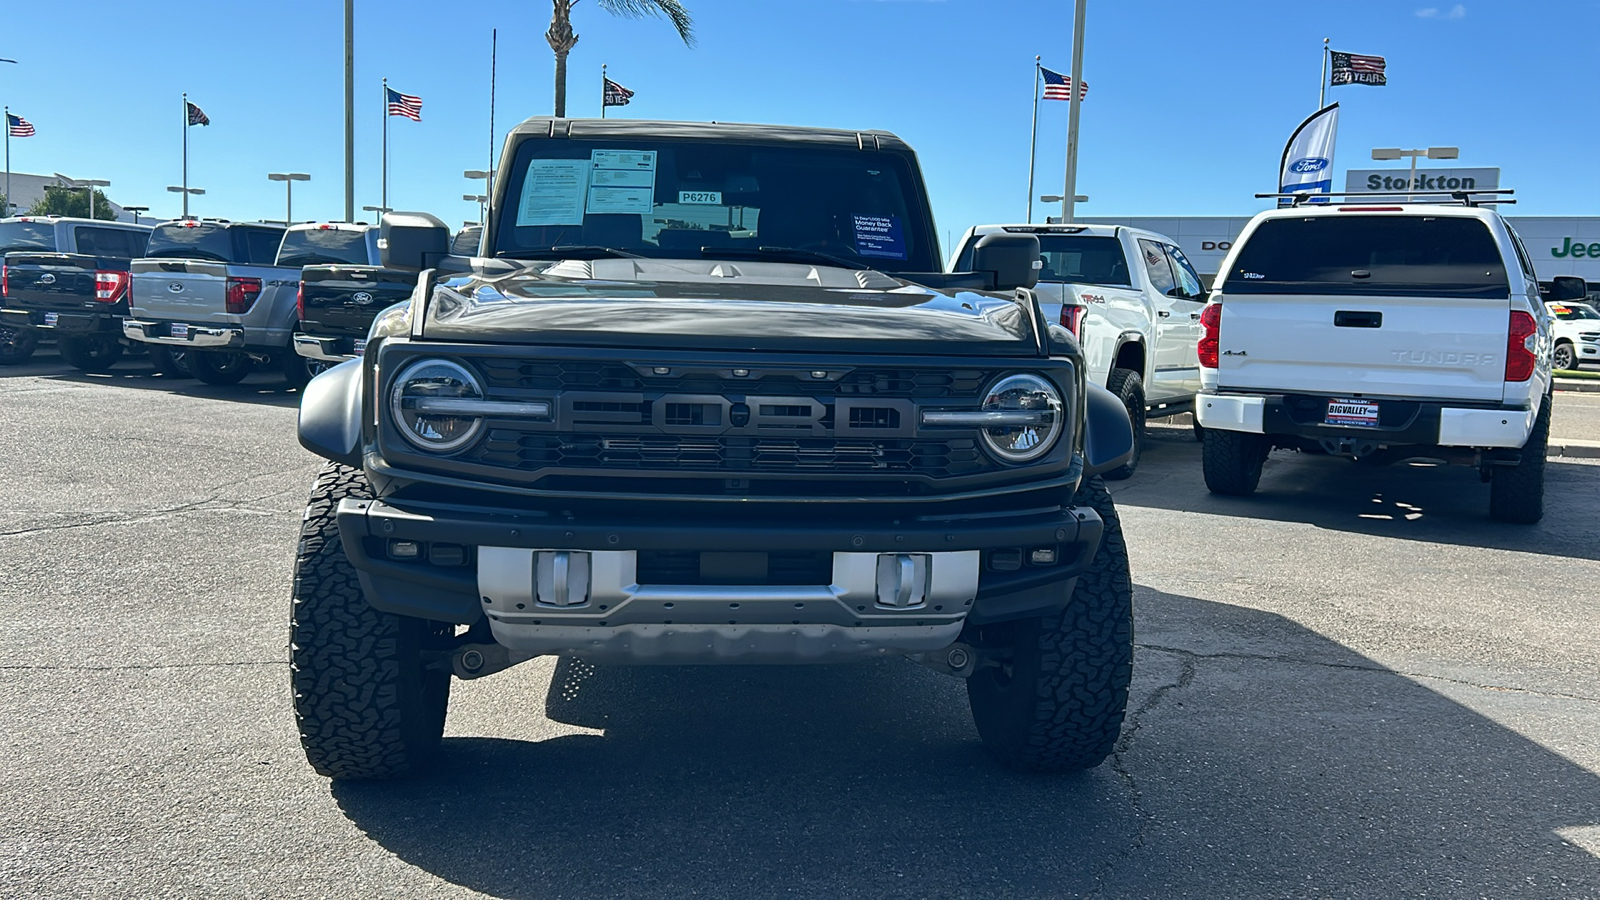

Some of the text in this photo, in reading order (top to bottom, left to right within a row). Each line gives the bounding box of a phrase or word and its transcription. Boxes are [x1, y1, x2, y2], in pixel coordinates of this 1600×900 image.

[1354, 72, 1386, 83] YEARS
[1296, 159, 1323, 172] Ford
[1367, 174, 1475, 190] Stockton
[683, 192, 716, 202] P6276
[1391, 350, 1498, 366] TUNDRA
[559, 390, 918, 438] FORD
